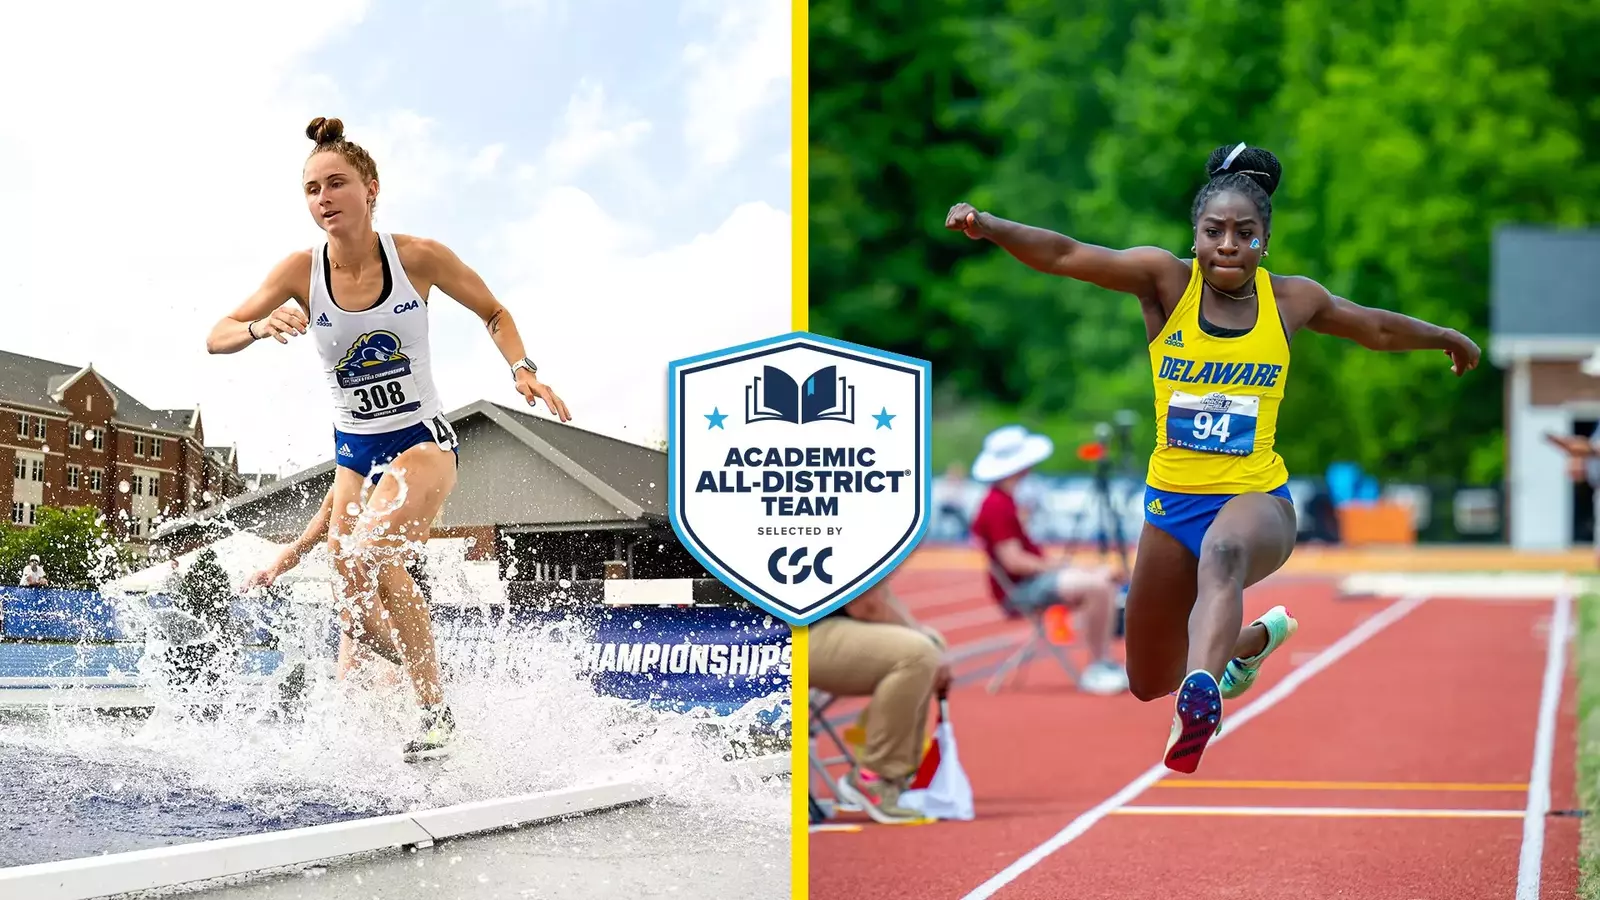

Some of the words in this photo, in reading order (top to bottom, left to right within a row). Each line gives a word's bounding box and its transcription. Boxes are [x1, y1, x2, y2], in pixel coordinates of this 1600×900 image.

[393, 300, 419, 314] CAA
[1164, 339, 1184, 348] adidas
[1158, 355, 1282, 388] DELAWARE
[353, 381, 406, 412] 308
[432, 416, 455, 446] 4
[1192, 411, 1231, 443] 94
